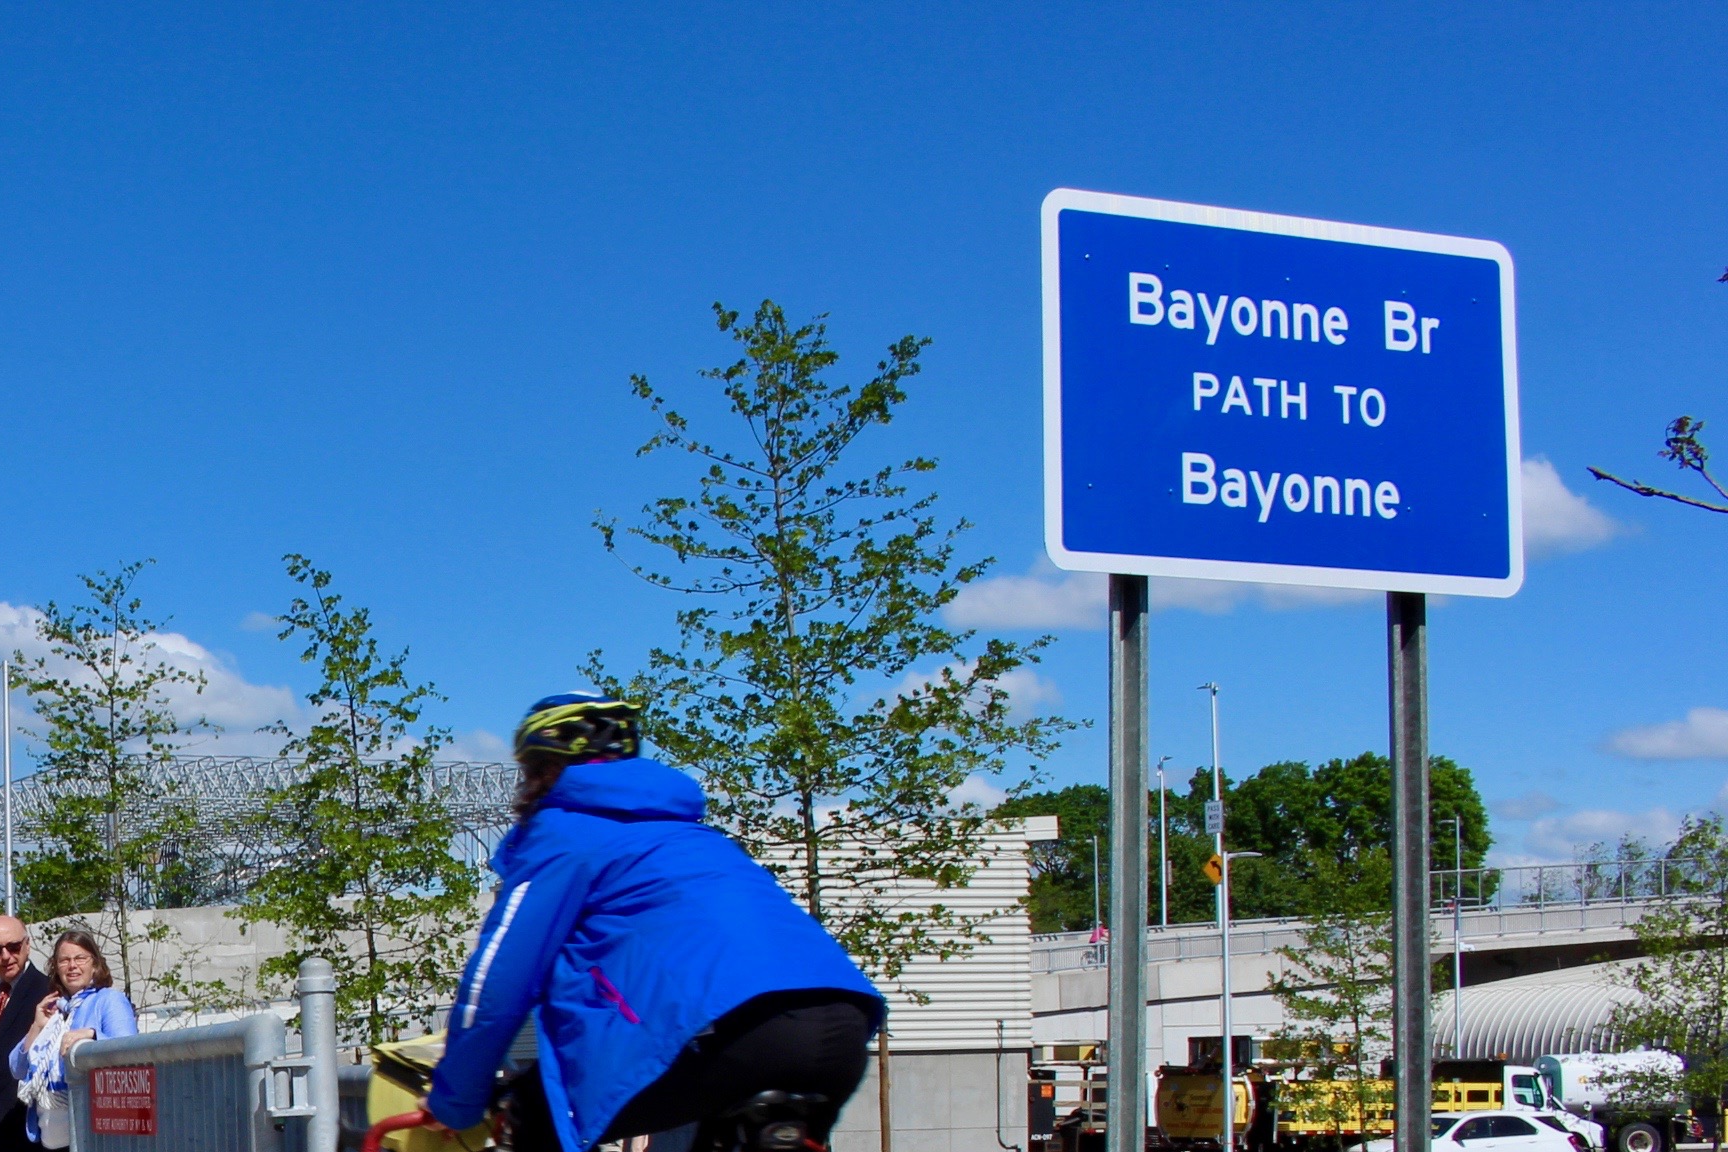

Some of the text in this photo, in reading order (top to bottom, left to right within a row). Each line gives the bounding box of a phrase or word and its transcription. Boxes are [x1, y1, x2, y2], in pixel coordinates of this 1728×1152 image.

[1128, 271, 1440, 354] Bayonne Br
[1192, 371, 1386, 427] PATH TO
[1181, 451, 1401, 523] Bayonne
[95, 1070, 150, 1094] NO TRESPASSING
